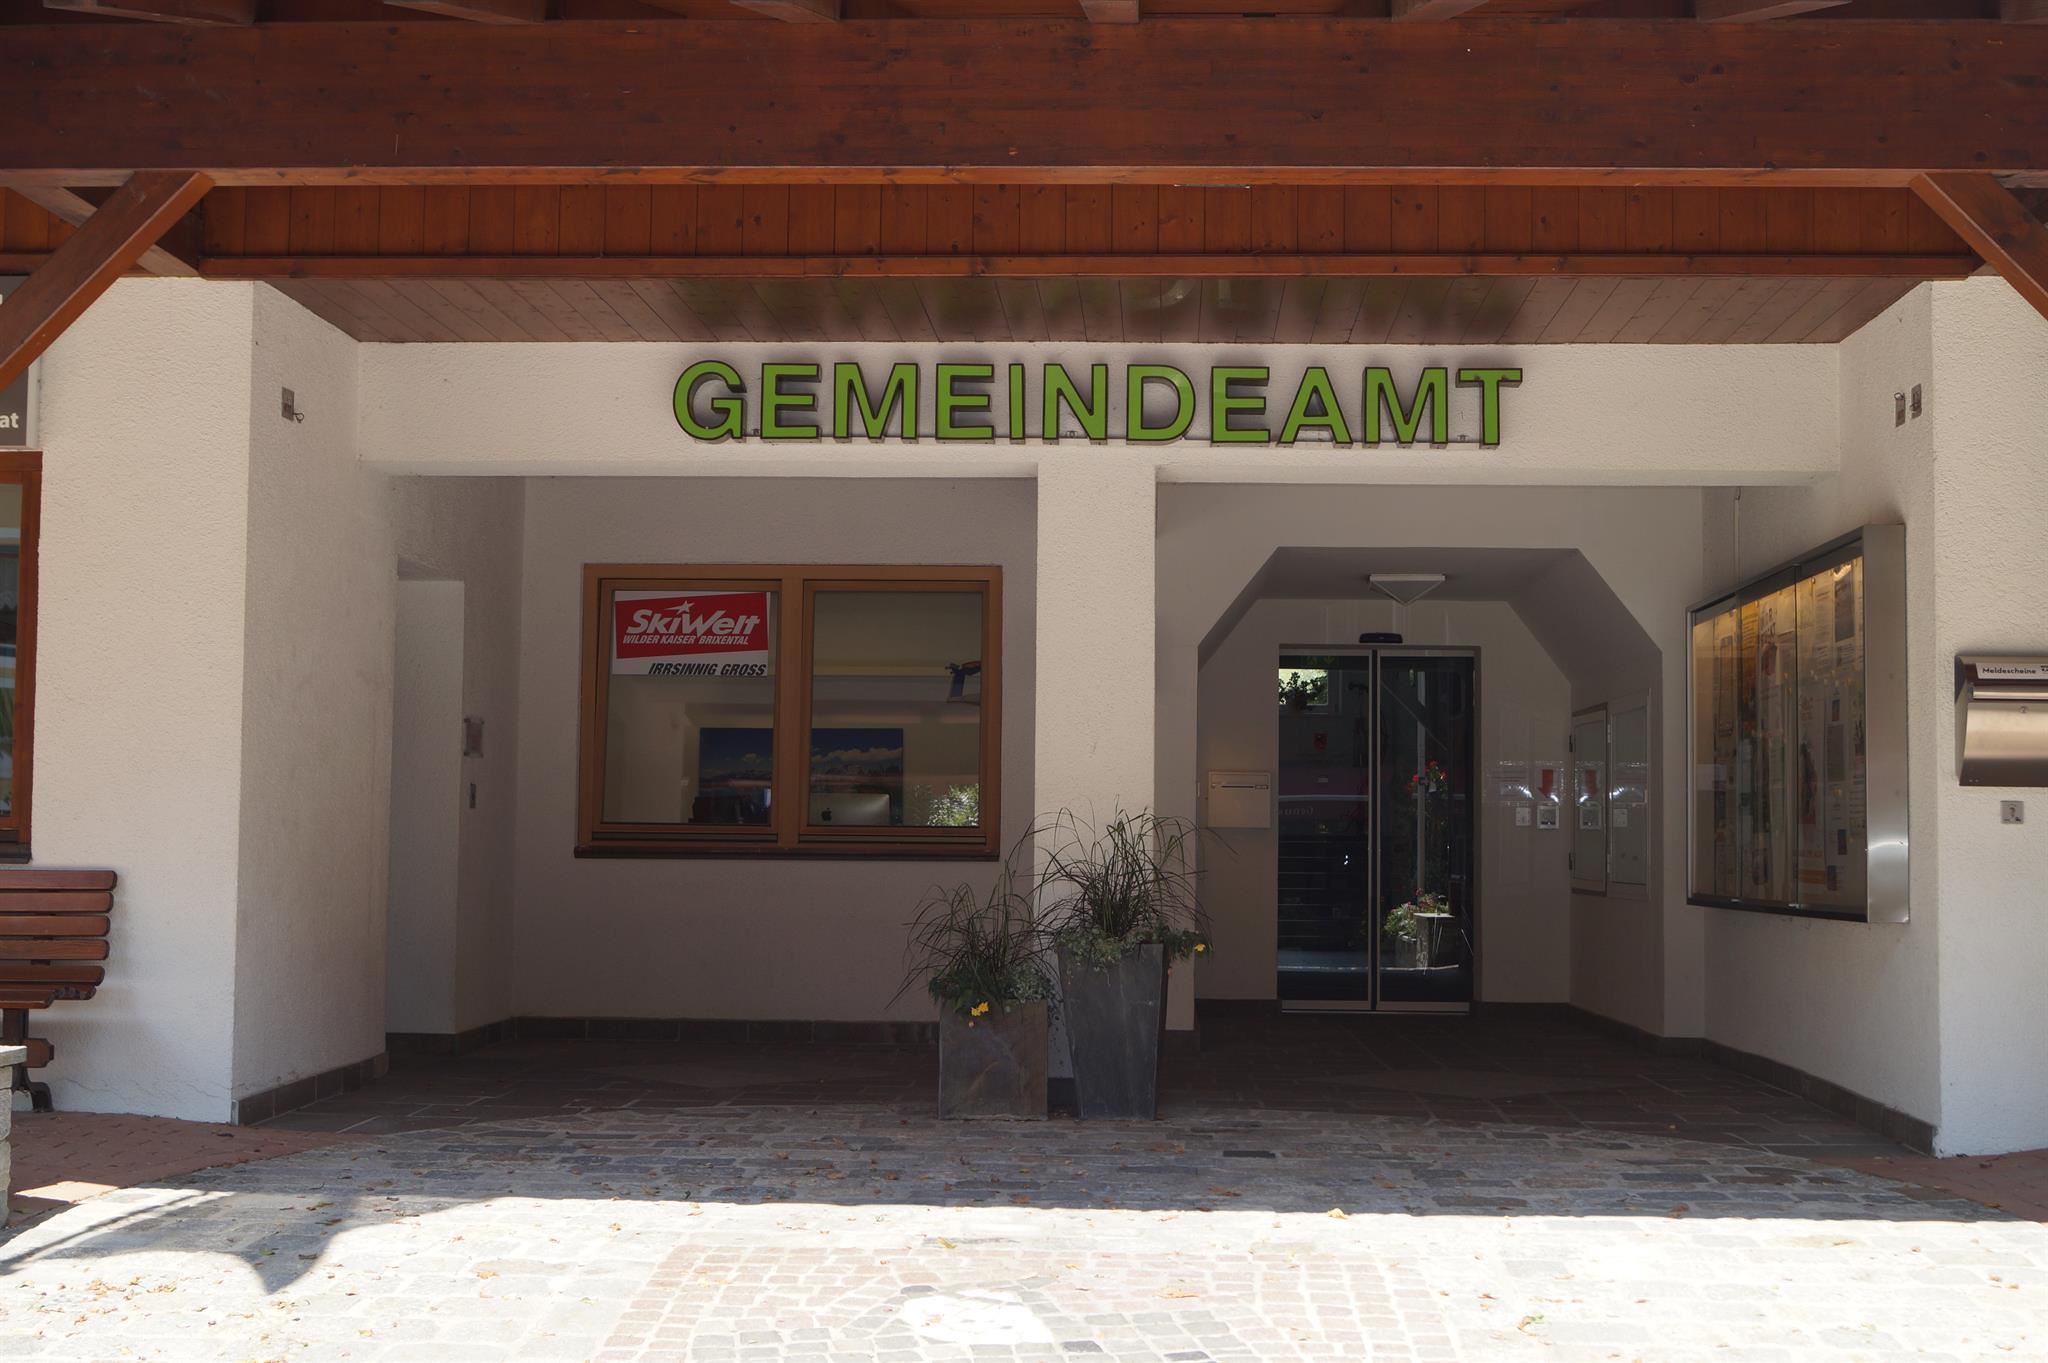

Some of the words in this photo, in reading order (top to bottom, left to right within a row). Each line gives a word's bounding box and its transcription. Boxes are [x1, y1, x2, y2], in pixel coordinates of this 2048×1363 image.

[673, 360, 1522, 444] GEMEINDEAMT
[626, 608, 761, 637] SkiWelt
[623, 635, 660, 645] WILDER
[660, 635, 696, 645] KAISER
[698, 635, 749, 645] BRIXENTAL
[648, 662, 717, 676] IRRSINNIG
[720, 663, 767, 677] GROSS
[1982, 667, 2037, 675] Meldescheine
